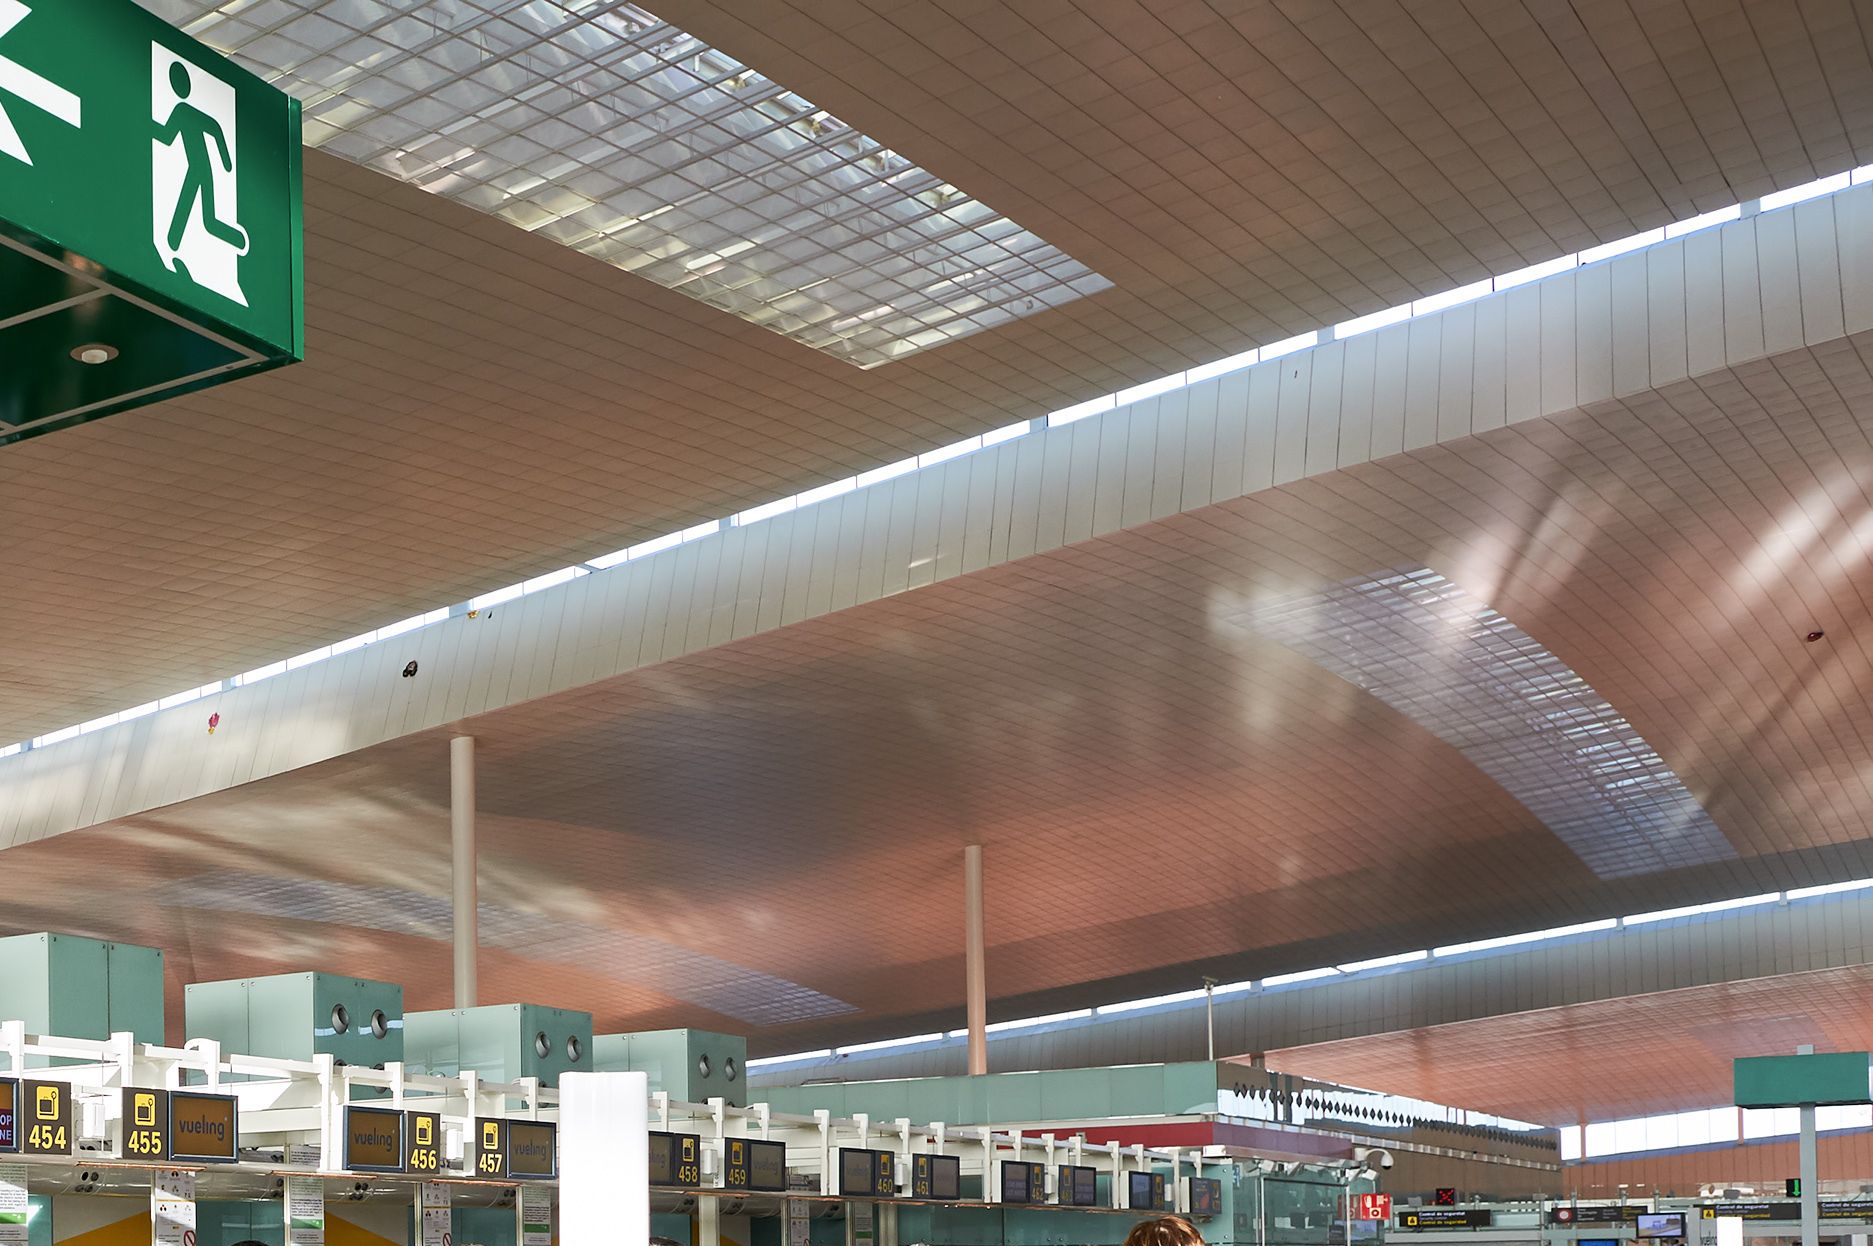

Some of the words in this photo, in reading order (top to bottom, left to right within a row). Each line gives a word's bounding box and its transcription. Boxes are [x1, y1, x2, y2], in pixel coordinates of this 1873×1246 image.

[29, 1124, 66, 1149] 454
[179, 1114, 226, 1141] vueling
[128, 1130, 162, 1154] 455
[354, 1127, 393, 1152] vueling
[410, 1148, 437, 1169] 456
[479, 1153, 503, 1173] 457
[678, 1165, 698, 1183] 458
[728, 1169, 746, 1185] 459
